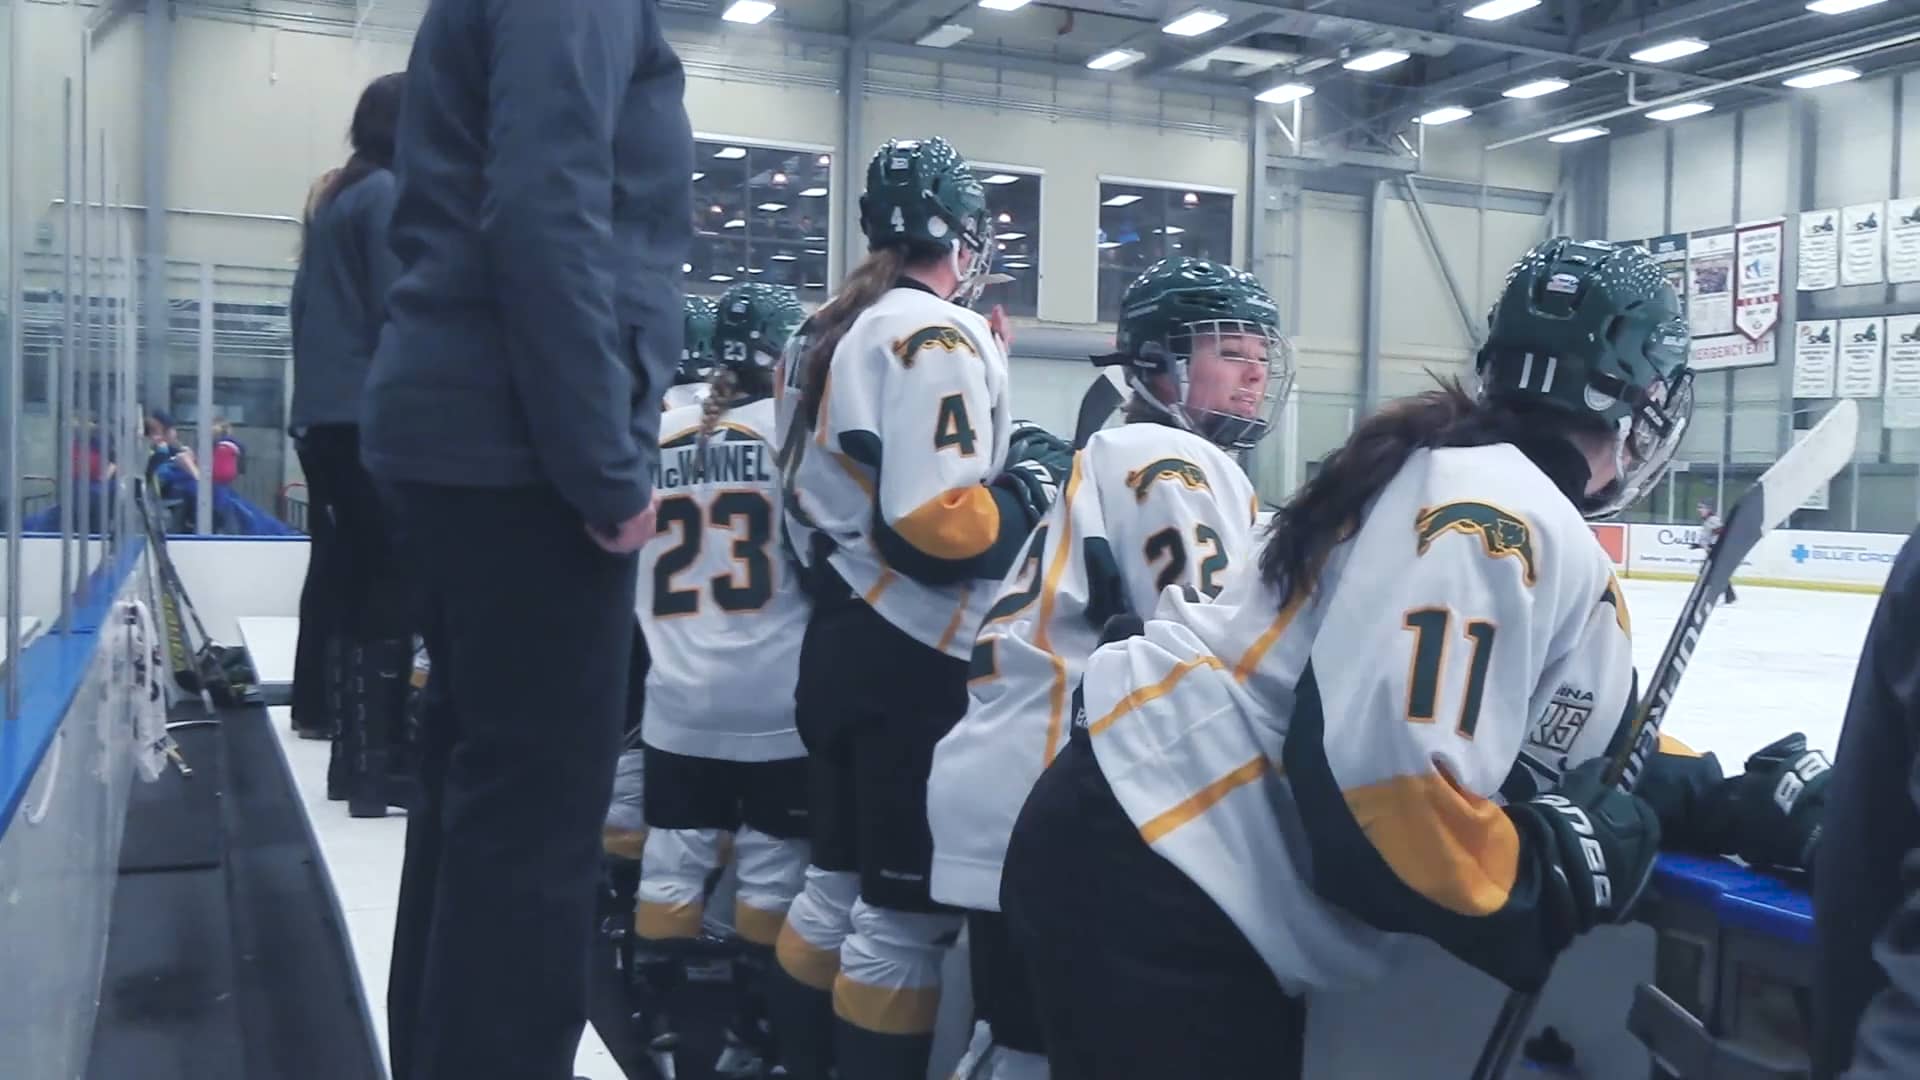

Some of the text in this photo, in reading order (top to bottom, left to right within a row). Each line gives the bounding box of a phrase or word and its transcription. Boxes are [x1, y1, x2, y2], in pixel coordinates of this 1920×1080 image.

[891, 206, 905, 232] 4
[723, 340, 748, 361] 23
[1518, 352, 1558, 393] 11
[1691, 344, 1744, 361] ERGENCY
[933, 392, 978, 459] 4
[652, 488, 774, 620] 23
[1143, 521, 1229, 604] 22
[1812, 550, 1897, 563] BLUE CRO
[1405, 607, 1498, 741] 11
[1615, 583, 1714, 795] SUPREM
